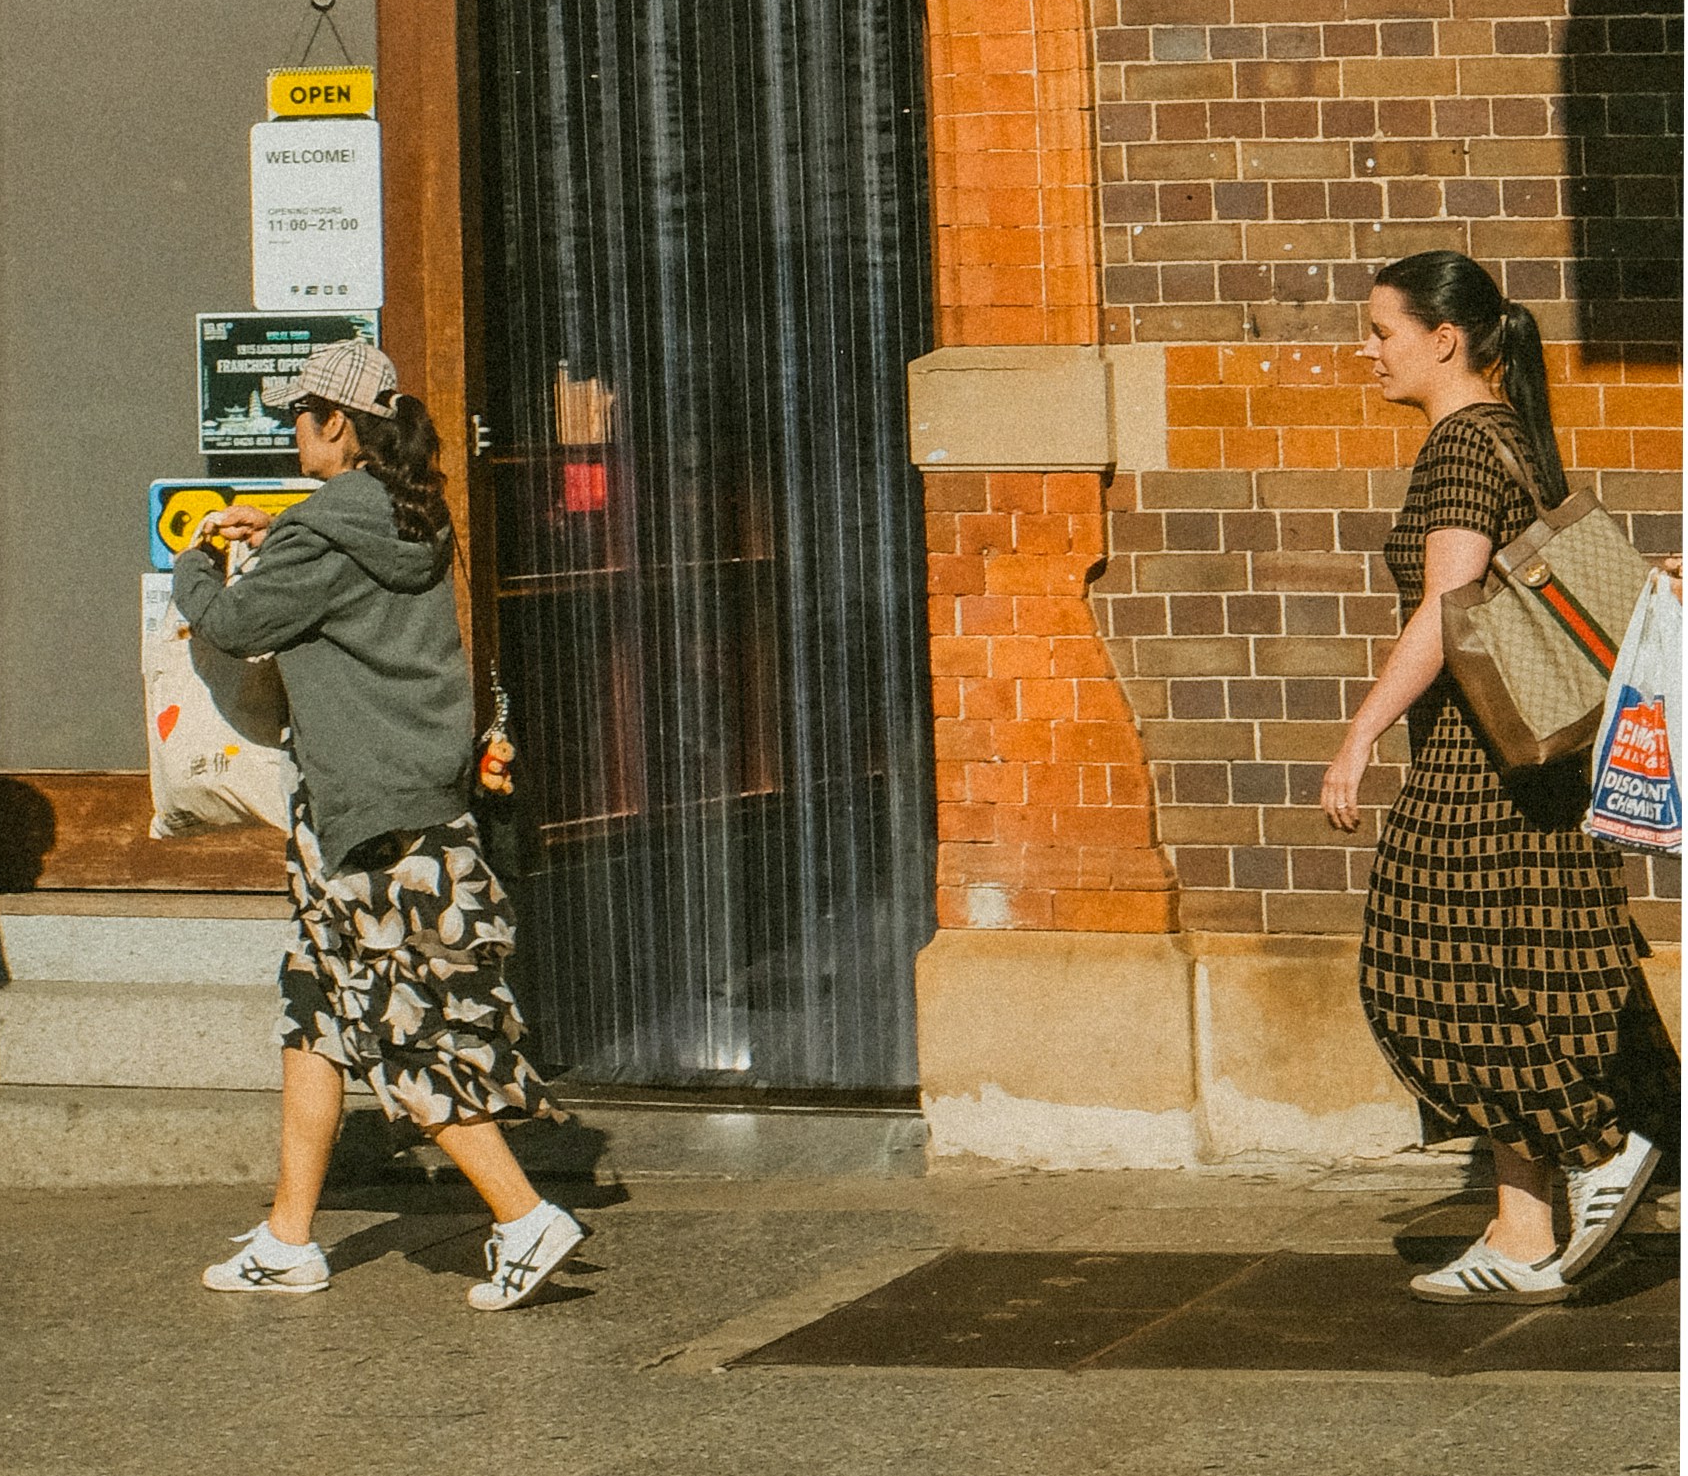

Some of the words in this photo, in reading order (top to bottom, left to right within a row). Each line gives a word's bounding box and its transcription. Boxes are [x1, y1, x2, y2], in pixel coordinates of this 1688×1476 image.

[289, 85, 352, 104] OPEN
[265, 149, 356, 164] WELCOME!
[216, 359, 276, 373] FRANCHISE
